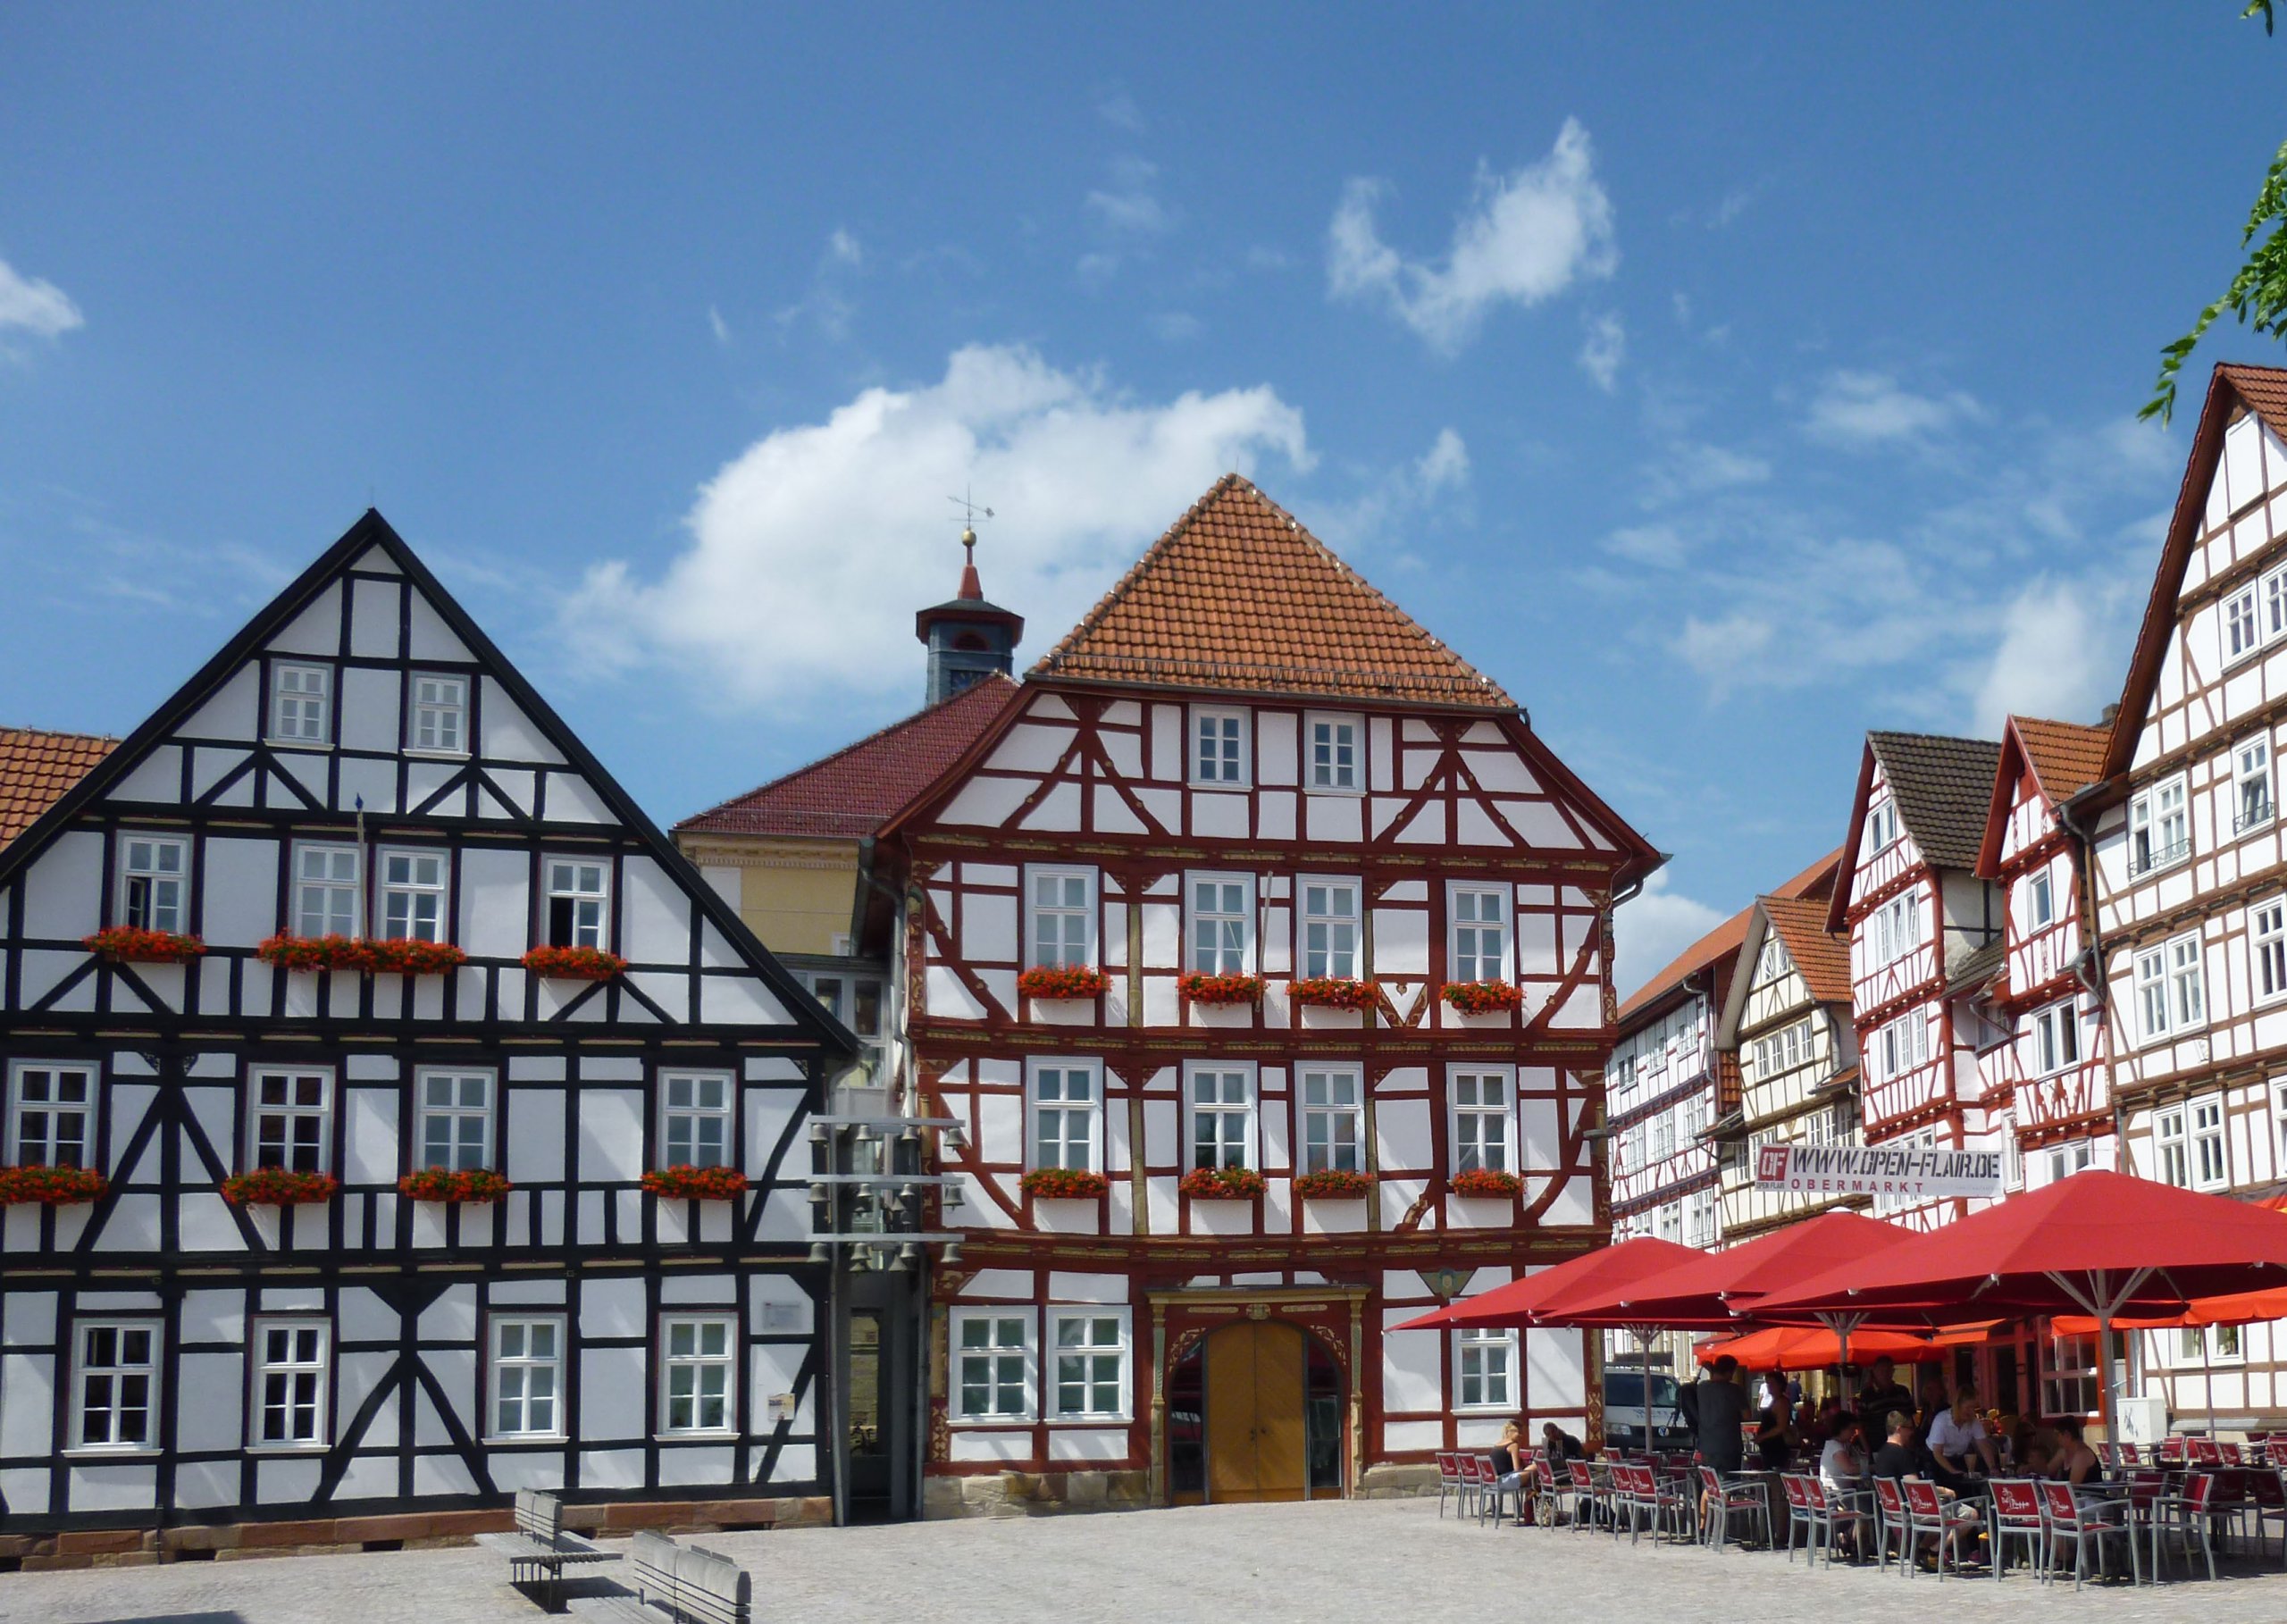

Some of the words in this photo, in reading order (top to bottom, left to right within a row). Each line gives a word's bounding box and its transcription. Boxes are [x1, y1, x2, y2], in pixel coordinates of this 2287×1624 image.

[1762, 1151, 1786, 1176] OF
[1793, 1148, 2000, 1178] WWW.OPEN-FLAIR.DE
[1791, 1178, 1923, 1193] OBERMARKT
